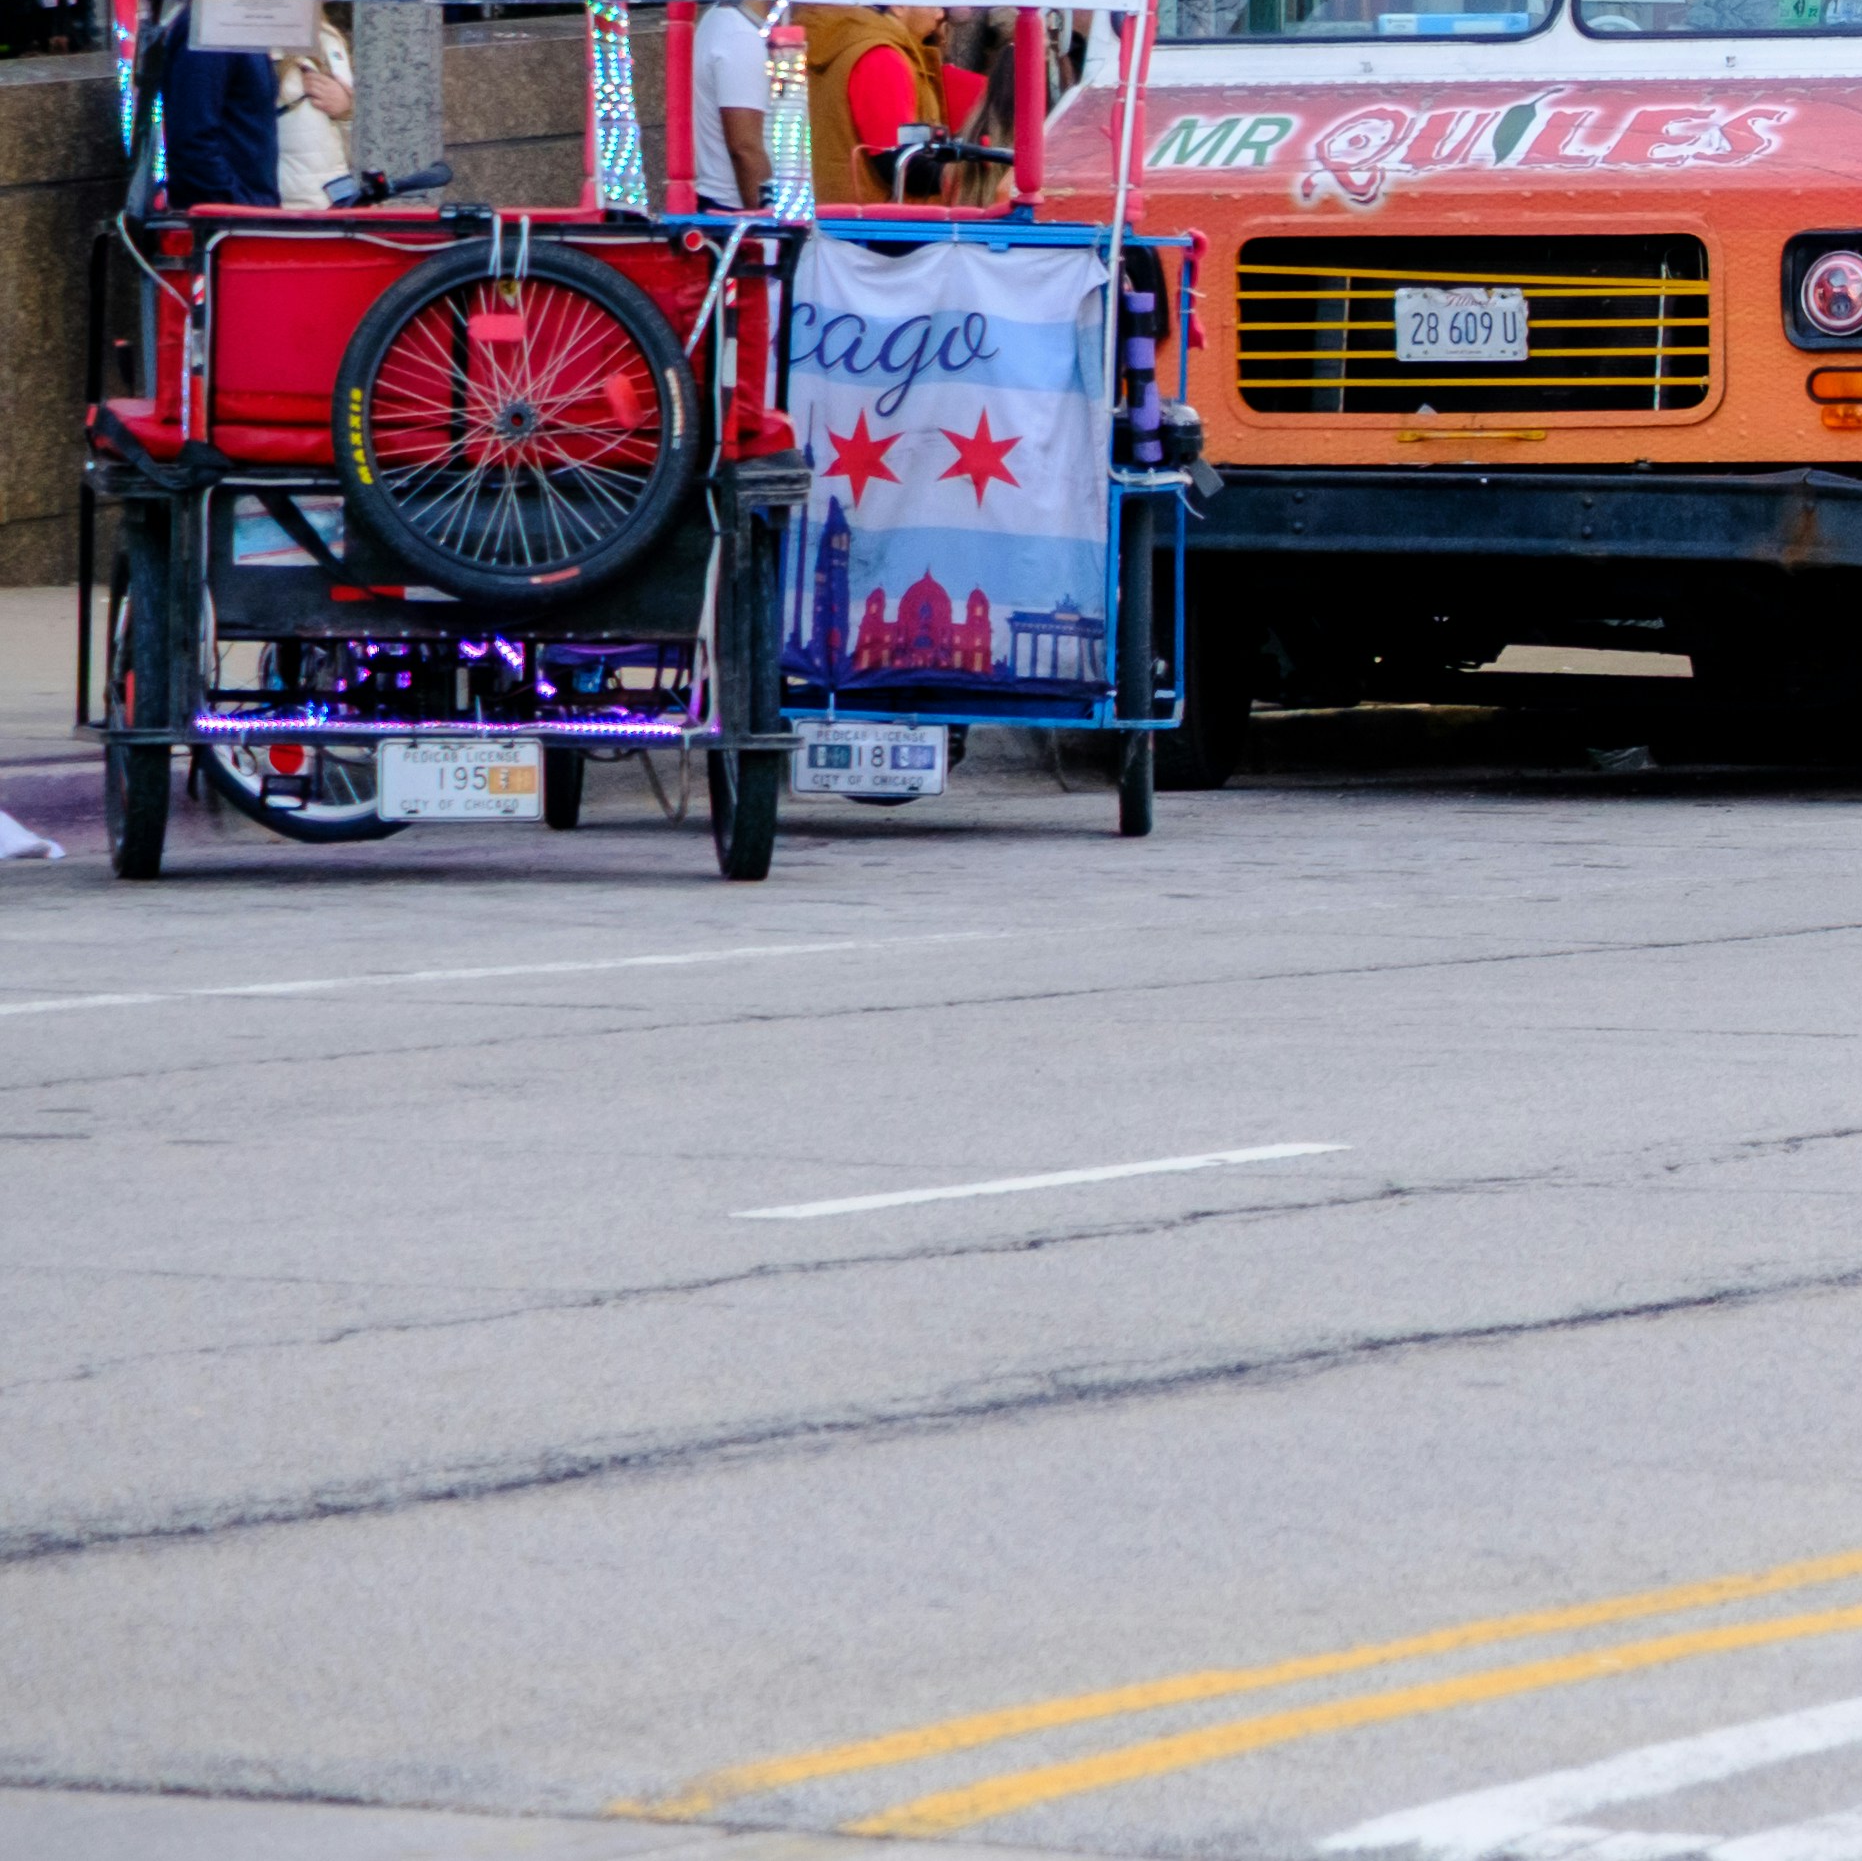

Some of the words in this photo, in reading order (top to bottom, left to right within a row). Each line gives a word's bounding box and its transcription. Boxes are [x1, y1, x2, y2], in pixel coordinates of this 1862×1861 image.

[1147, 113, 1295, 168] MR
[1410, 311, 1440, 346] 28
[1449, 311, 1494, 345] 609
[1502, 311, 1518, 344] U
[348, 387, 375, 486] MAXXIS
[403, 750, 459, 764] PEDICAB
[466, 750, 521, 763] LICENSE
[811, 774, 840, 786] CITY
[847, 775, 863, 786] OF
[872, 775, 924, 787] CHICAGO
[400, 799, 430, 811] CITY
[438, 799, 455, 811] OF
[464, 799, 520, 811] CHICAGO
